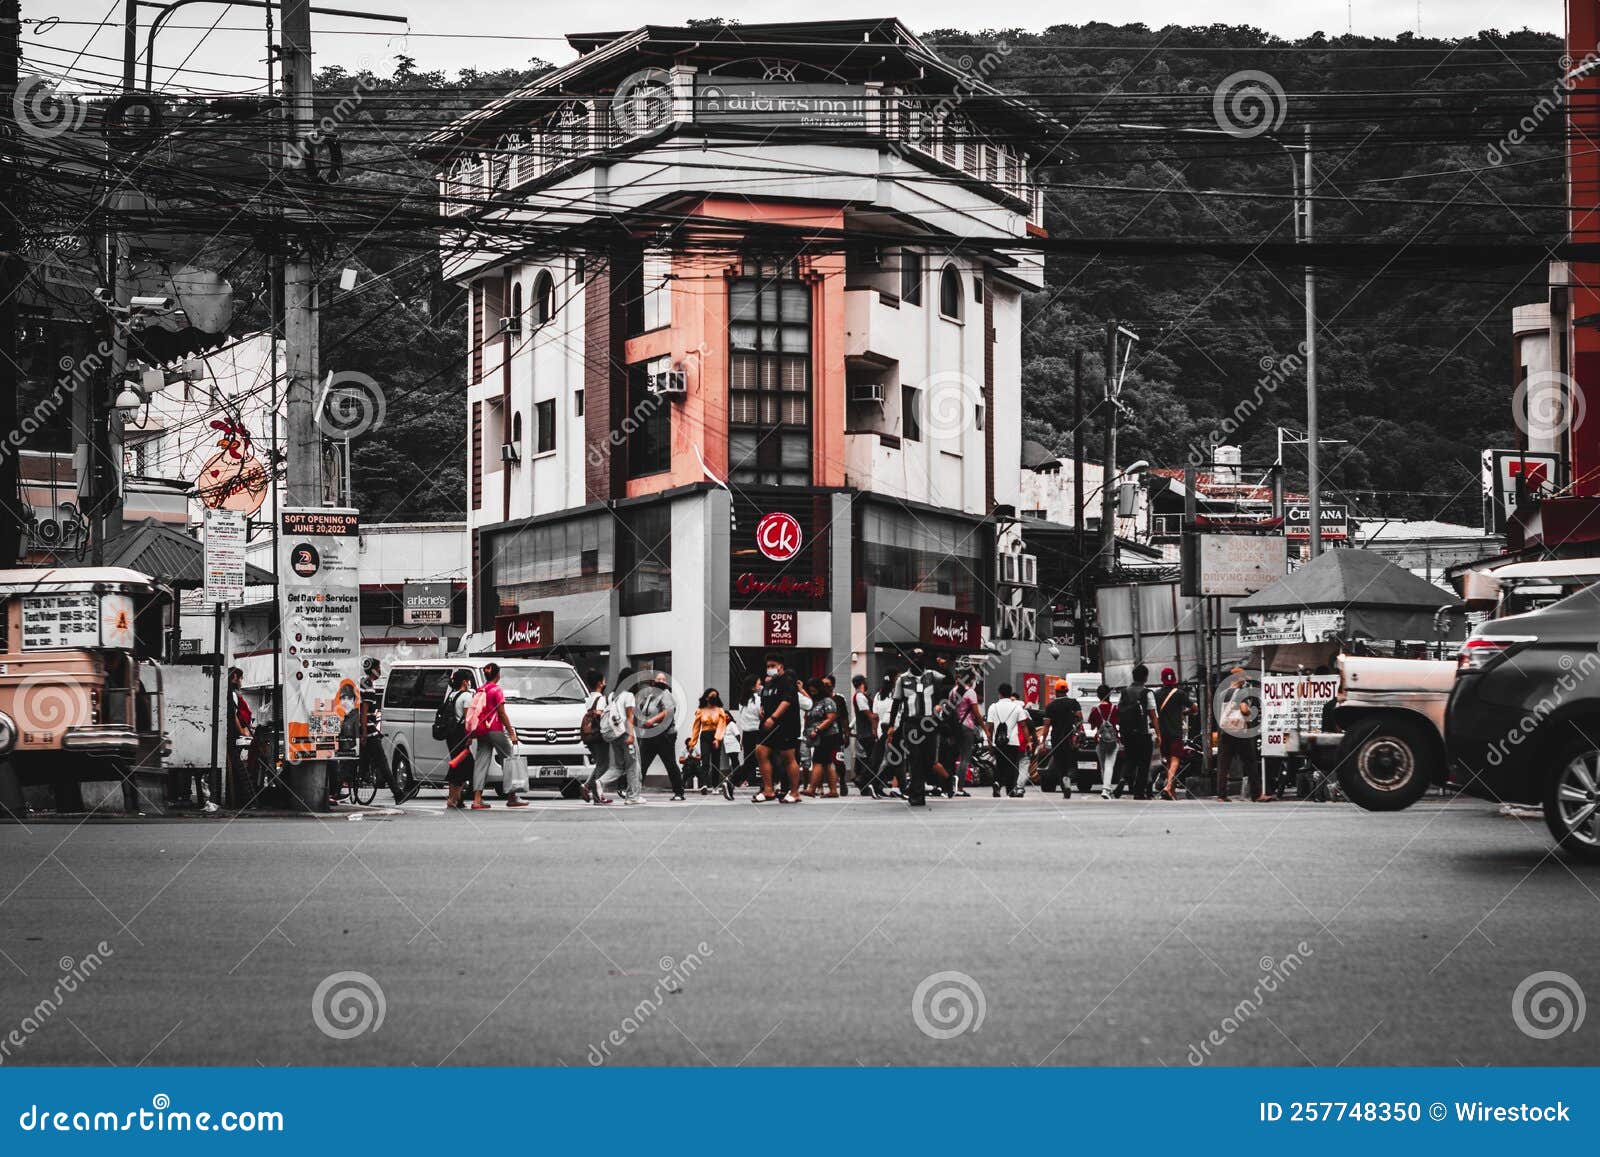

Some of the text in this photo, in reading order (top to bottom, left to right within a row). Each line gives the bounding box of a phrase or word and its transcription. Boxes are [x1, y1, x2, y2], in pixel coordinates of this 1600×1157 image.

[1289, 507, 1343, 520] CEANA
[284, 515, 358, 525] SOFT OPENING ON
[292, 524, 347, 534] JUNE 20,2022
[326, 593, 358, 603] Services
[407, 595, 447, 605] arlene's
[295, 604, 352, 615] at your hands!
[771, 613, 792, 621] OPEN
[773, 620, 790, 633] 24
[932, 615, 965, 643] howking
[321, 635, 344, 643] Delivery
[1264, 680, 1336, 699] POLICE OUTPOST
[1268, 734, 1281, 745] GOD
